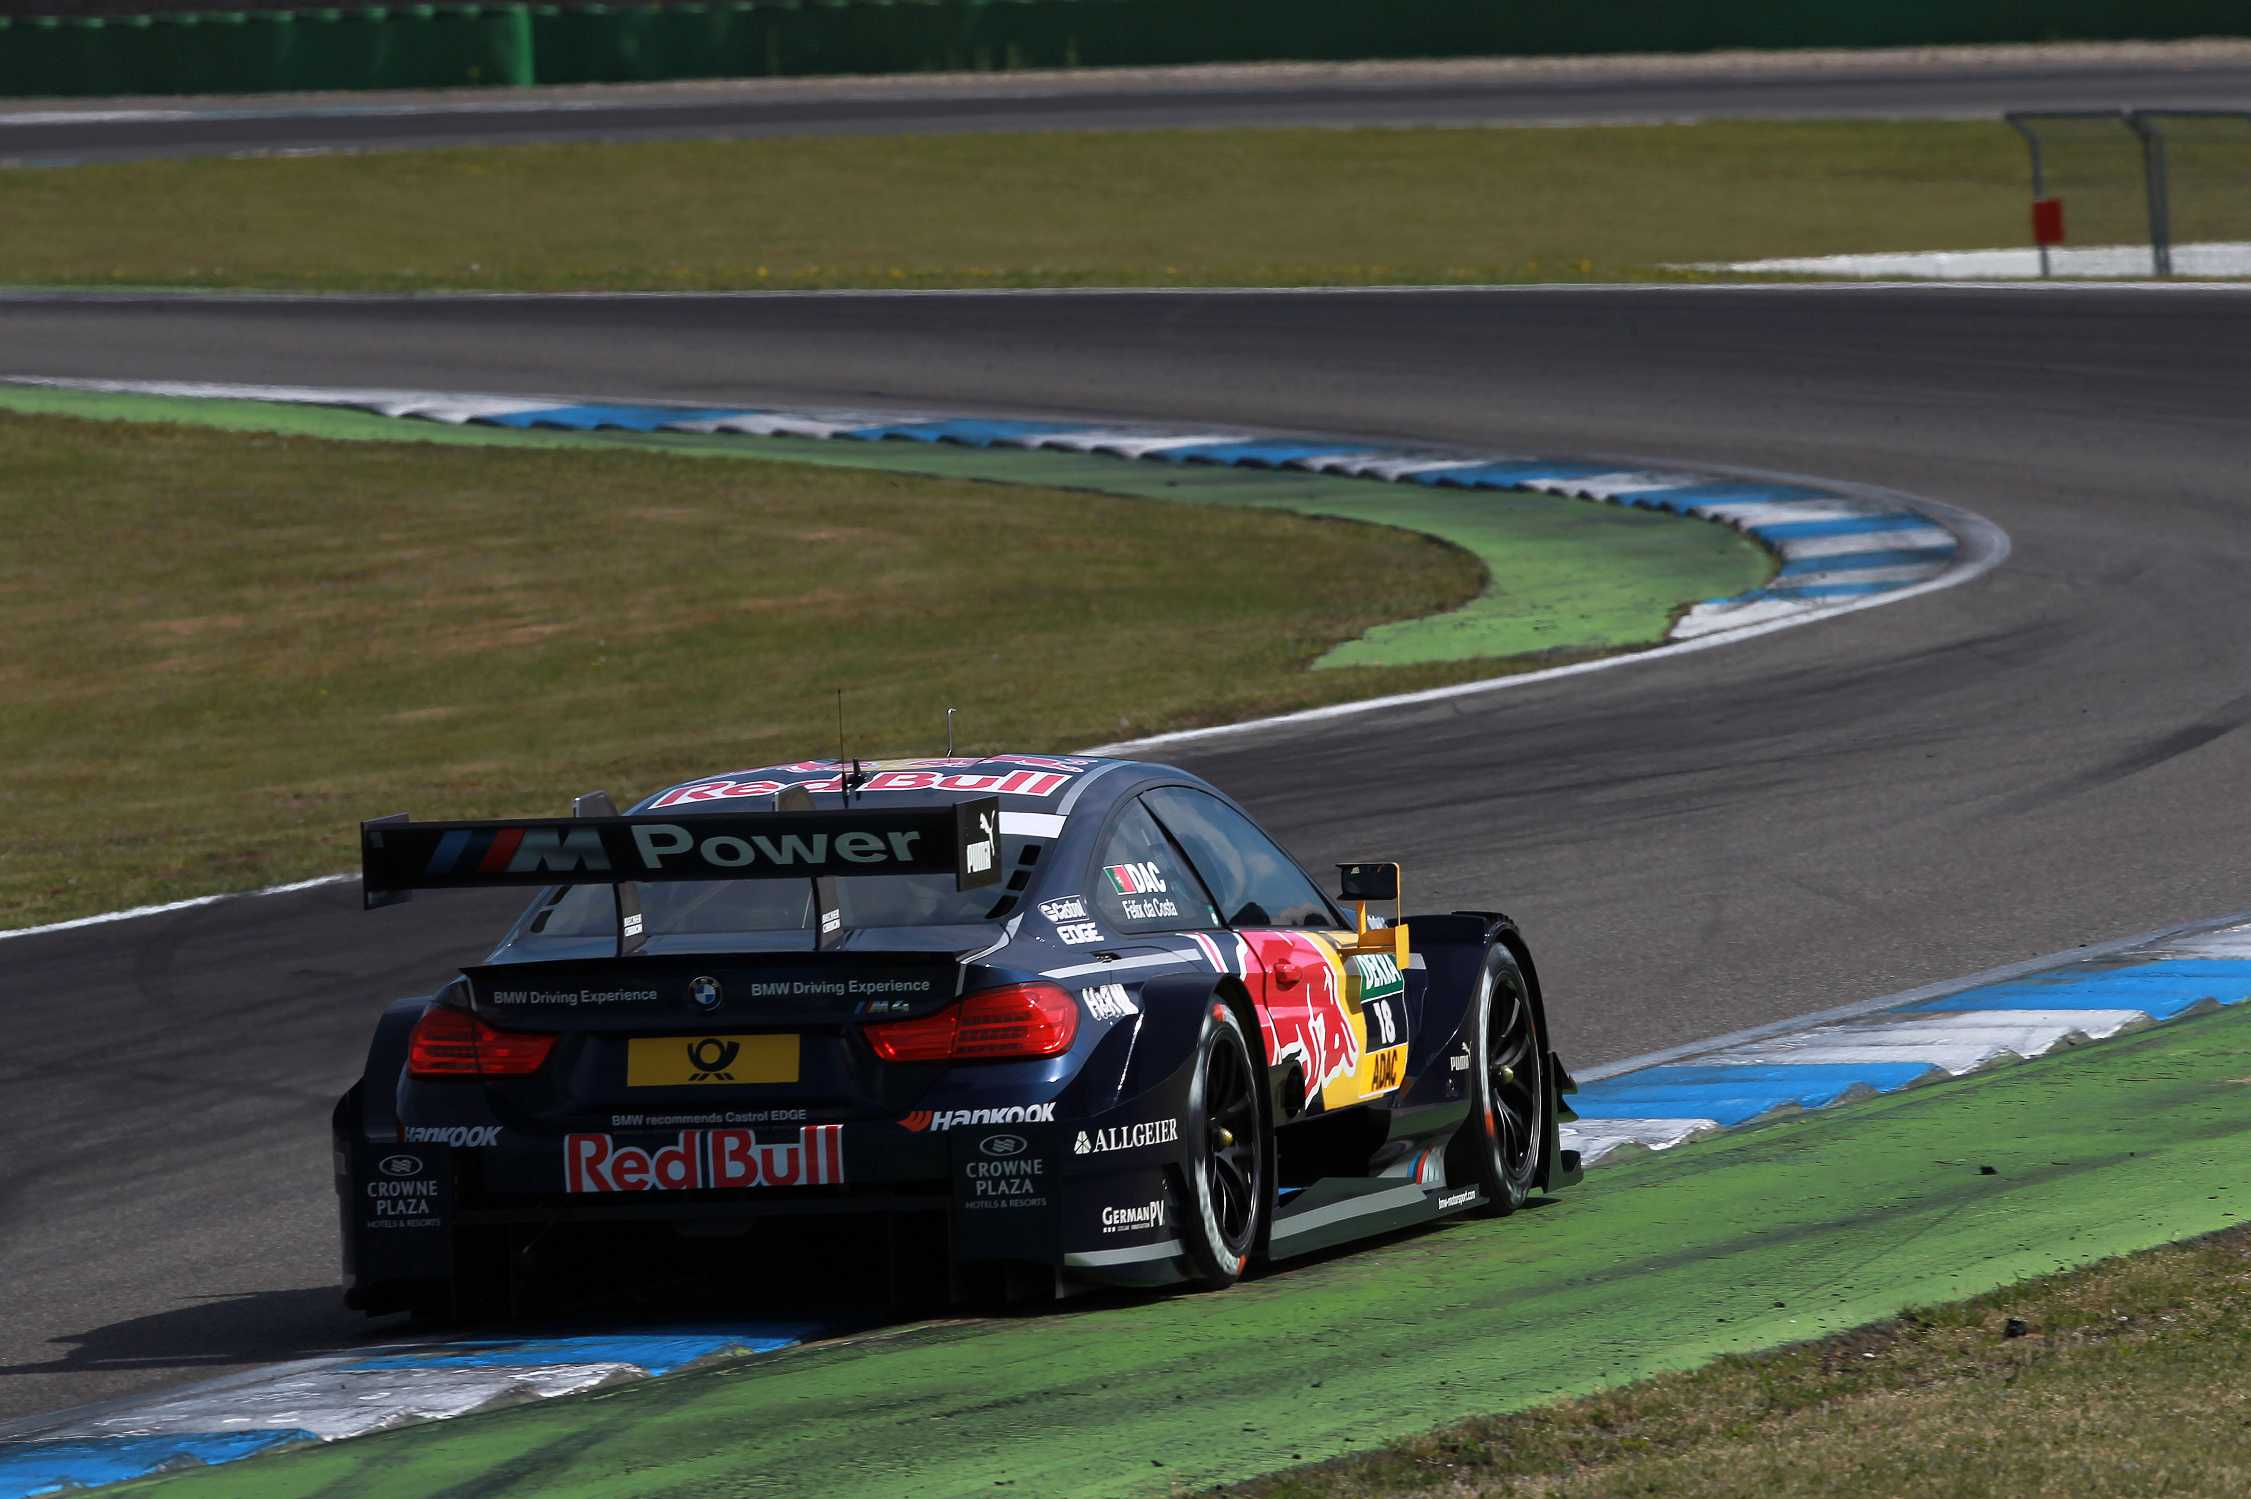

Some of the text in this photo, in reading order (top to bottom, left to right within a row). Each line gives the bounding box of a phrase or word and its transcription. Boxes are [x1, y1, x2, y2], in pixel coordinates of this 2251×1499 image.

[649, 770, 1072, 809] Red Bull
[631, 824, 920, 869] Power
[1125, 861, 1167, 893] DAC
[1143, 901, 1153, 918] da
[1153, 898, 1178, 917] Costa
[1057, 922, 1105, 945] EDGE
[494, 988, 657, 1006] BMW Driving Experience
[751, 978, 930, 997] BMW Driving Experience
[1373, 1002, 1396, 1043] 18
[1372, 1050, 1398, 1090] ADAC
[612, 1108, 807, 1126] BMW recommends Castrol EDGE
[1092, 1117, 1179, 1153] ALLGEIER
[565, 1124, 845, 1192] Red Bull
[966, 1158, 1044, 1178] CROWNE
[367, 1180, 439, 1197] CROWNE
[976, 1178, 1035, 1196] PLAZA
[376, 1198, 430, 1216] PLAZA
